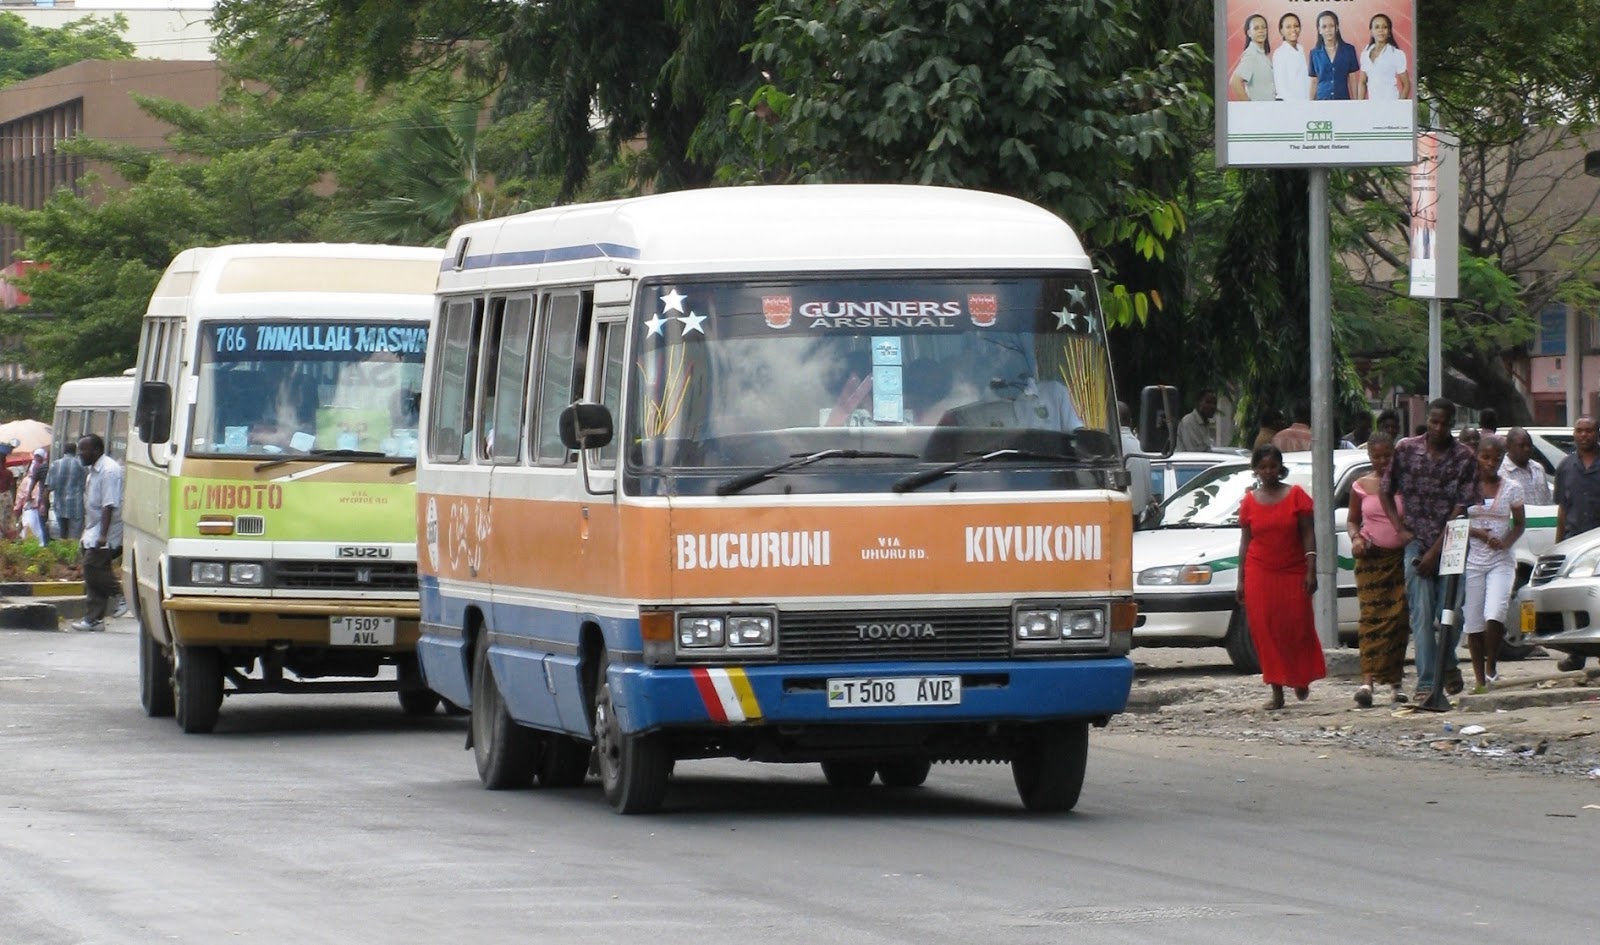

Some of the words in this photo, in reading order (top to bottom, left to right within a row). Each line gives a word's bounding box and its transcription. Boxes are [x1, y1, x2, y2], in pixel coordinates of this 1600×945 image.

[1306, 131, 1333, 141] BANK
[799, 300, 962, 318] GUNNERS
[809, 316, 955, 329] ARSENAL
[216, 326, 246, 352] 786
[354, 326, 430, 352] MASWA
[877, 537, 900, 547] VIA
[965, 525, 1102, 562] KIVUKONI
[338, 547, 389, 557] ISUZU
[861, 549, 906, 559] UHURU
[855, 623, 936, 639] TOYOTA
[353, 632, 379, 644] AVL
[916, 680, 953, 702] AVB
